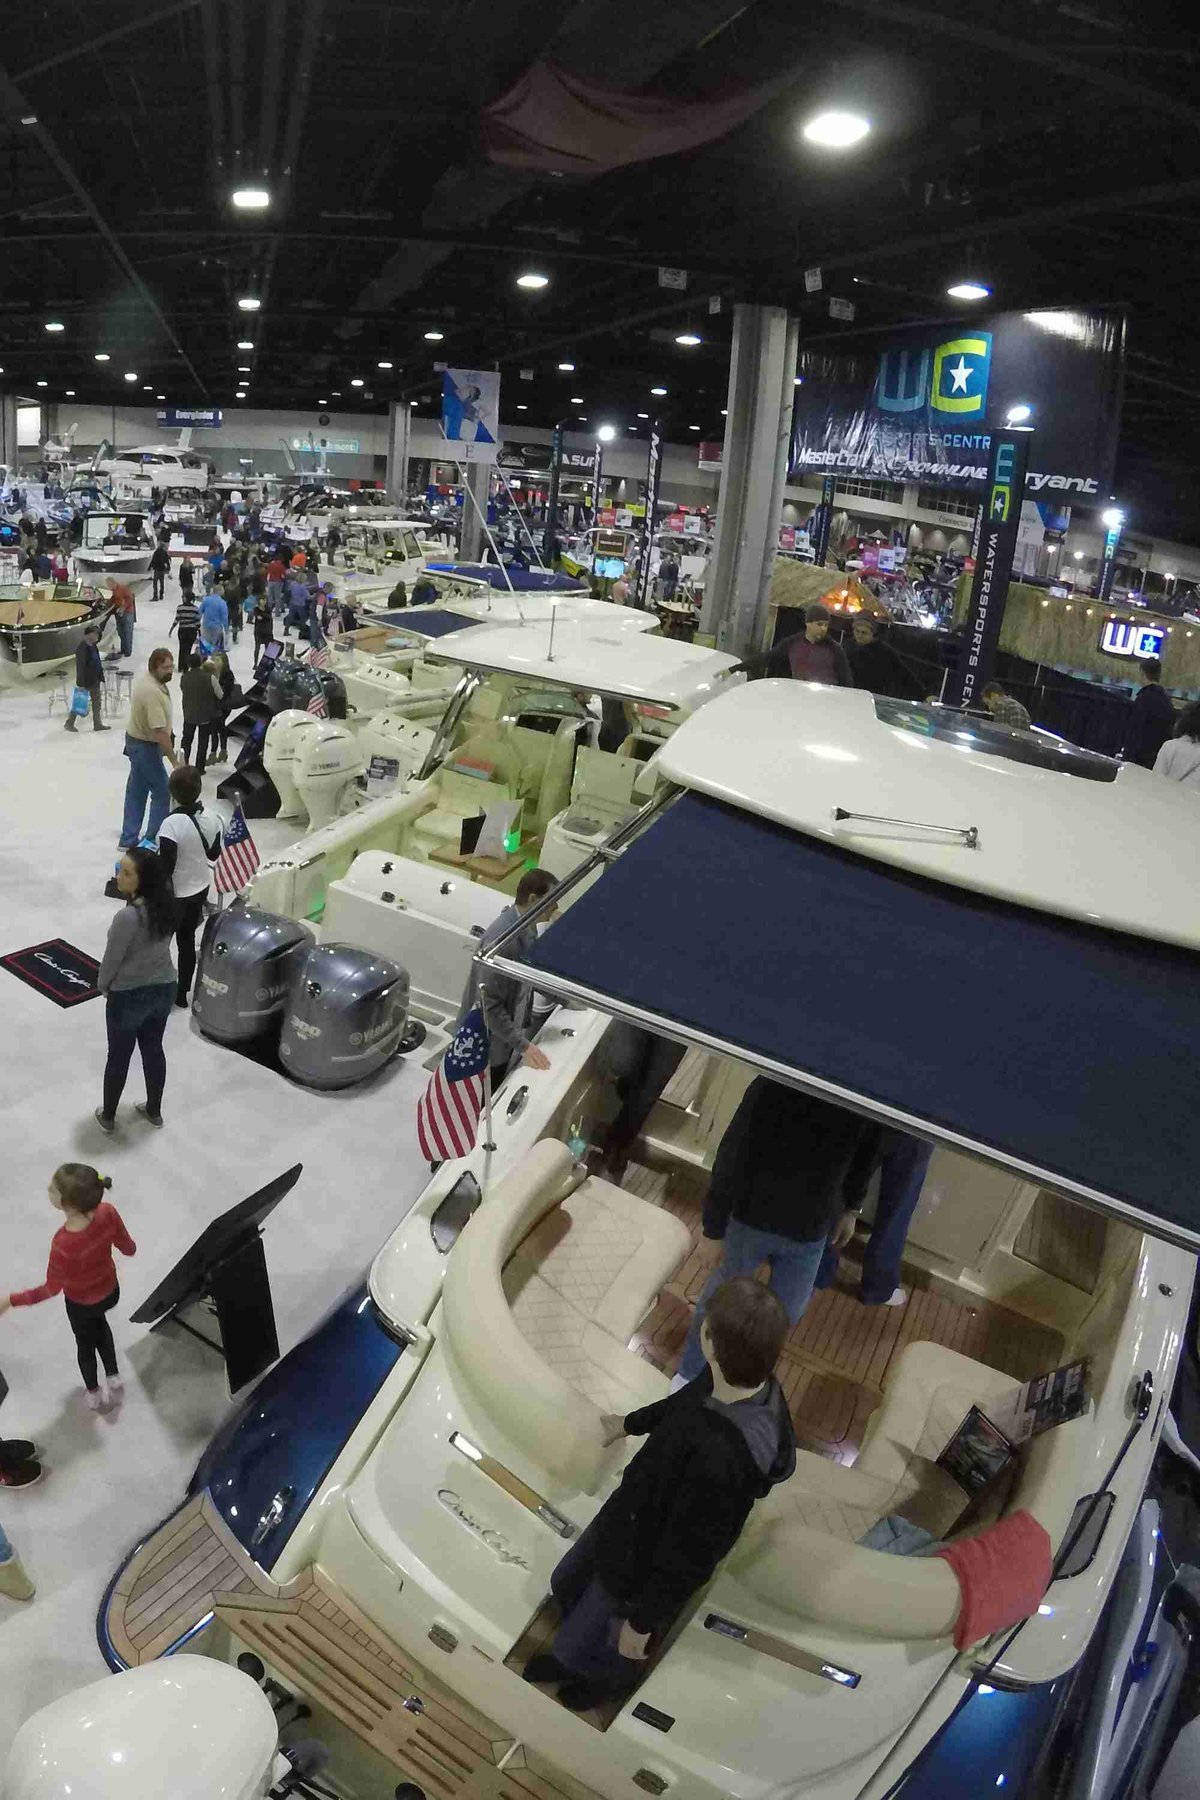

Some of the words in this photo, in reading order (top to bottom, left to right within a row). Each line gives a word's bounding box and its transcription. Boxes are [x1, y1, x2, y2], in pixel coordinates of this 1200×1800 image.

[943, 434, 991, 449] CENTR
[1025, 471, 1099, 494] ryant
[968, 532, 999, 667] WATERSPORTS
